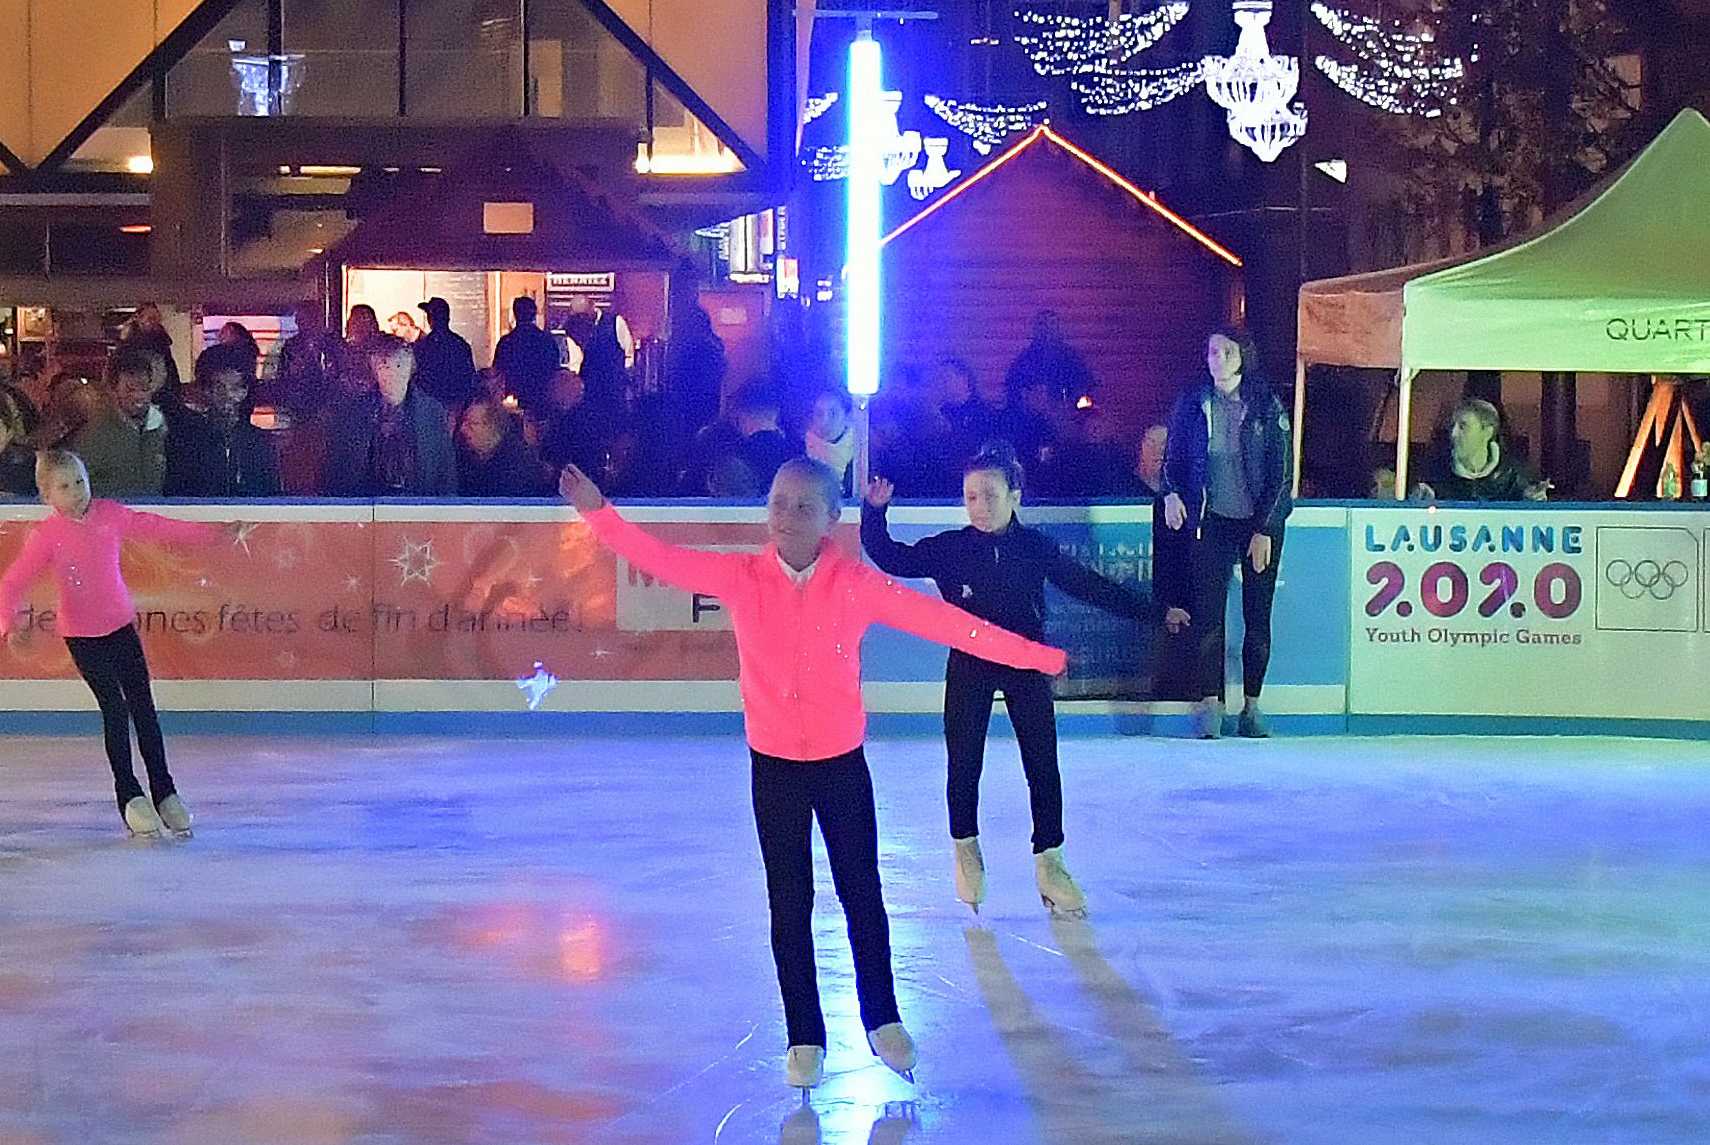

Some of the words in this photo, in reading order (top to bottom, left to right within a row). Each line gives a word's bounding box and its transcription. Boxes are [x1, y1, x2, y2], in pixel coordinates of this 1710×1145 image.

[1364, 525, 1583, 555] LAUSANNE
[221, 603, 300, 634] fêtes
[318, 605, 358, 634] de
[372, 603, 416, 632] fin
[1365, 628, 1421, 644] Youth
[1428, 629, 1509, 648] Olympic
[1516, 630, 1582, 646] Games
